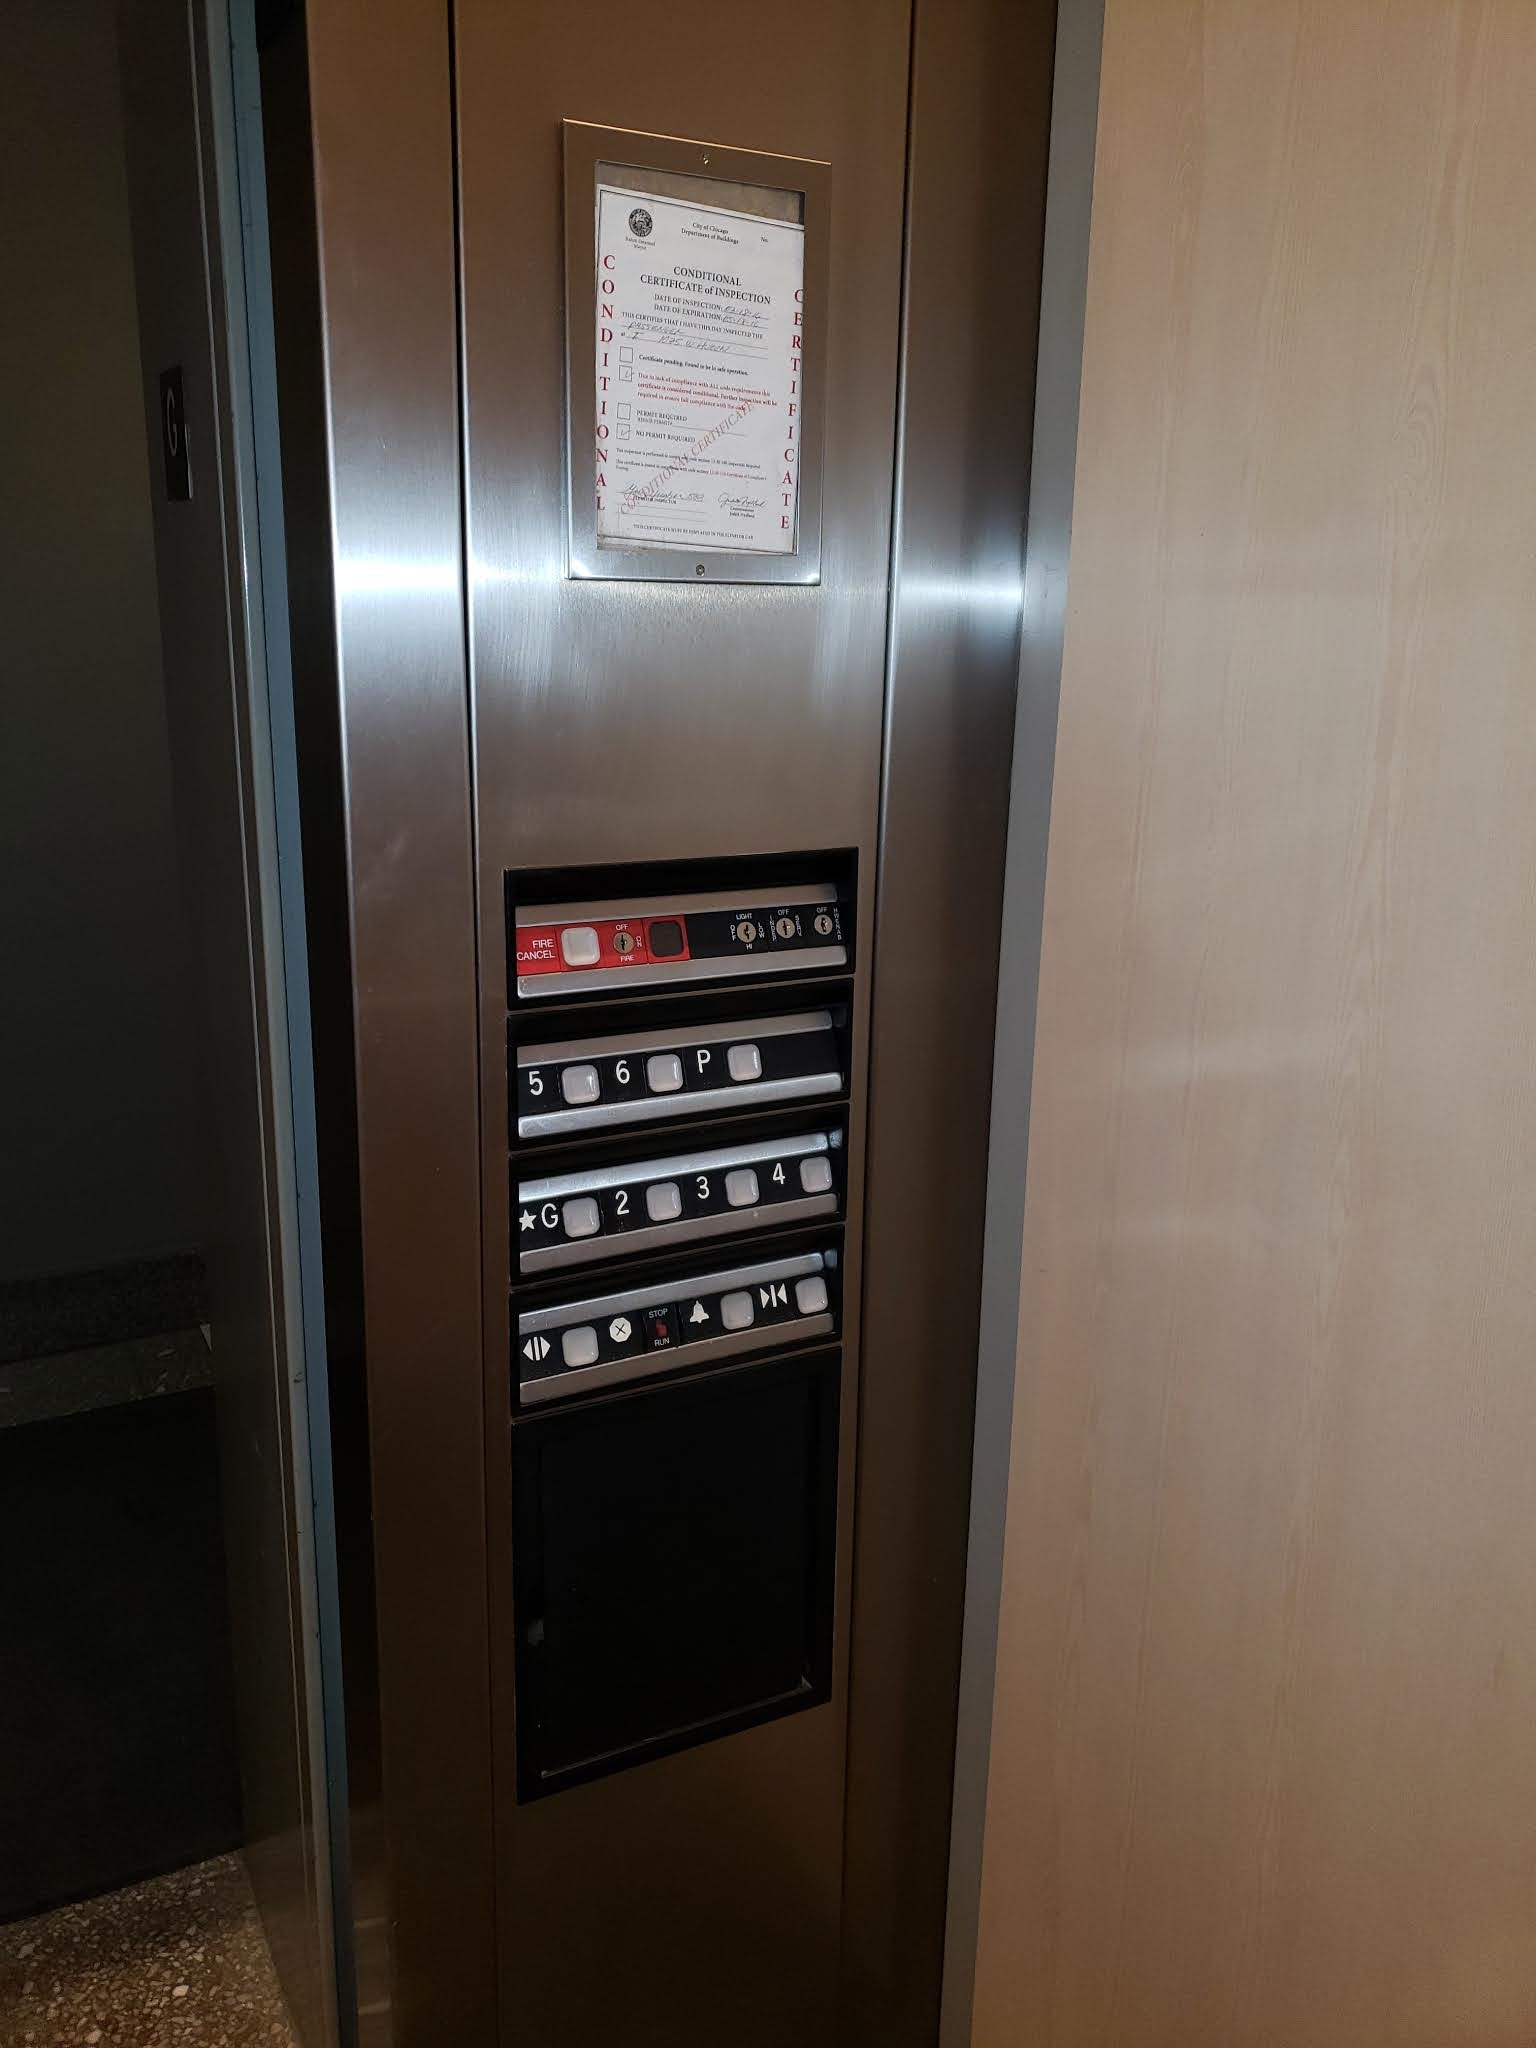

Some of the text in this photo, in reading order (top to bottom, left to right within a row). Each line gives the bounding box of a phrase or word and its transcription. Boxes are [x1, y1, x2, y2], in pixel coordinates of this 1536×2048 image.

[692, 222, 703, 231] City
[709, 226, 729, 234] Chicago
[681, 228, 710, 239] Department
[716, 234, 739, 244] Buildings
[674, 266, 742, 286] CONDITIONAL
[640, 274, 771, 304] CERTIFICATE of INSPECTION
[654, 294, 672, 303] DATE
[682, 298, 723, 311] INSPECTION:
[654, 304, 672, 312] DATE
[682, 308, 722, 320] EXPIRATION:
[635, 313, 663, 323] CERTIFIES
[663, 317, 678, 326] THAT
[682, 320, 698, 328] HAVE
[698, 323, 711, 331] THIS
[722, 327, 752, 338] INSPECTED
[638, 354, 663, 363] Certificate
[638, 382, 661, 390] certificate
[666, 386, 692, 394] considered
[672, 378, 698, 387] compliance
[166, 387, 178, 457] G
[645, 431, 666, 440] PERMIT
[667, 434, 696, 442] REQUIRED
[736, 912, 752, 920] LIGHT
[532, 938, 554, 949] FIRE
[636, 936, 642, 948] ON
[516, 950, 556, 961] CANCEL
[620, 954, 635, 962] FIRE
[528, 1050, 712, 1096] 5 6 P
[540, 1162, 786, 1229] G 2 3 4
[648, 1308, 668, 1318] STOP
[654, 1337, 670, 1346] RUN
